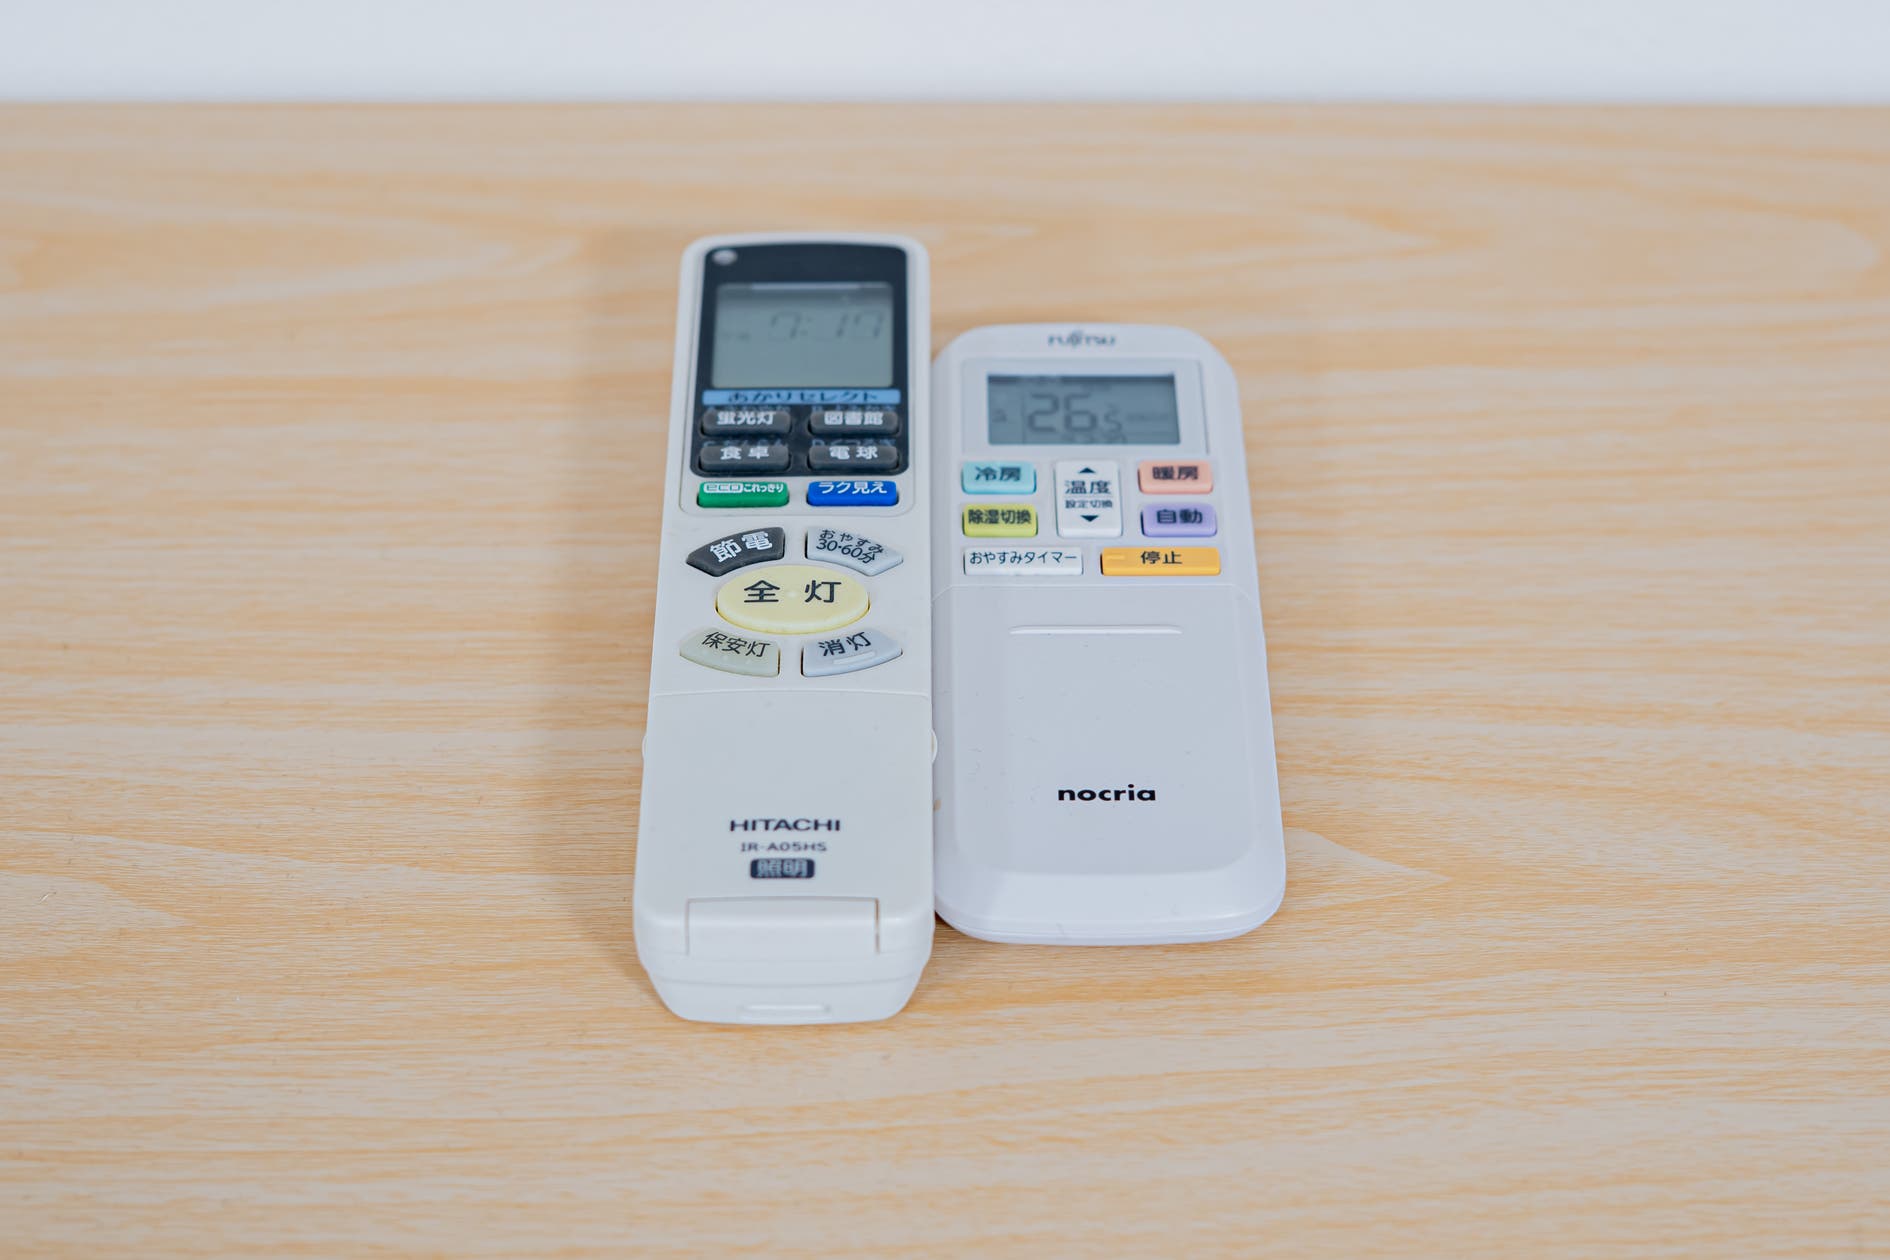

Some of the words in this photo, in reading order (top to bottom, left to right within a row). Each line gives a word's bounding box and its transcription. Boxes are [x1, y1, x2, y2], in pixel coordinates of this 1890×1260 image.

[728, 391, 878, 402] あかりセレクト
[717, 411, 776, 425] 蛍光灯
[824, 411, 884, 425] 図書館
[720, 446, 769, 460] 食卓
[829, 446, 878, 459] 電球
[975, 466, 1022, 481] 冷房
[1153, 466, 1198, 480] 暖房
[818, 482, 887, 494] ラク見え
[1065, 480, 1112, 494] 温度
[1065, 500, 1113, 508] 設定切換
[968, 509, 1032, 525] 除湿切換
[1156, 509, 1203, 524] 自動
[709, 531, 773, 563] 節電
[819, 528, 884, 554] おやすみ
[969, 552, 1077, 564] おやすみタイマー
[1140, 551, 1182, 565] 停止
[701, 631, 771, 658] 保安灯
[818, 631, 872, 657] 消灯
[1058, 784, 1156, 801] nocria
[730, 819, 840, 831] HITACHI
[741, 842, 827, 852] IR-A05HS
